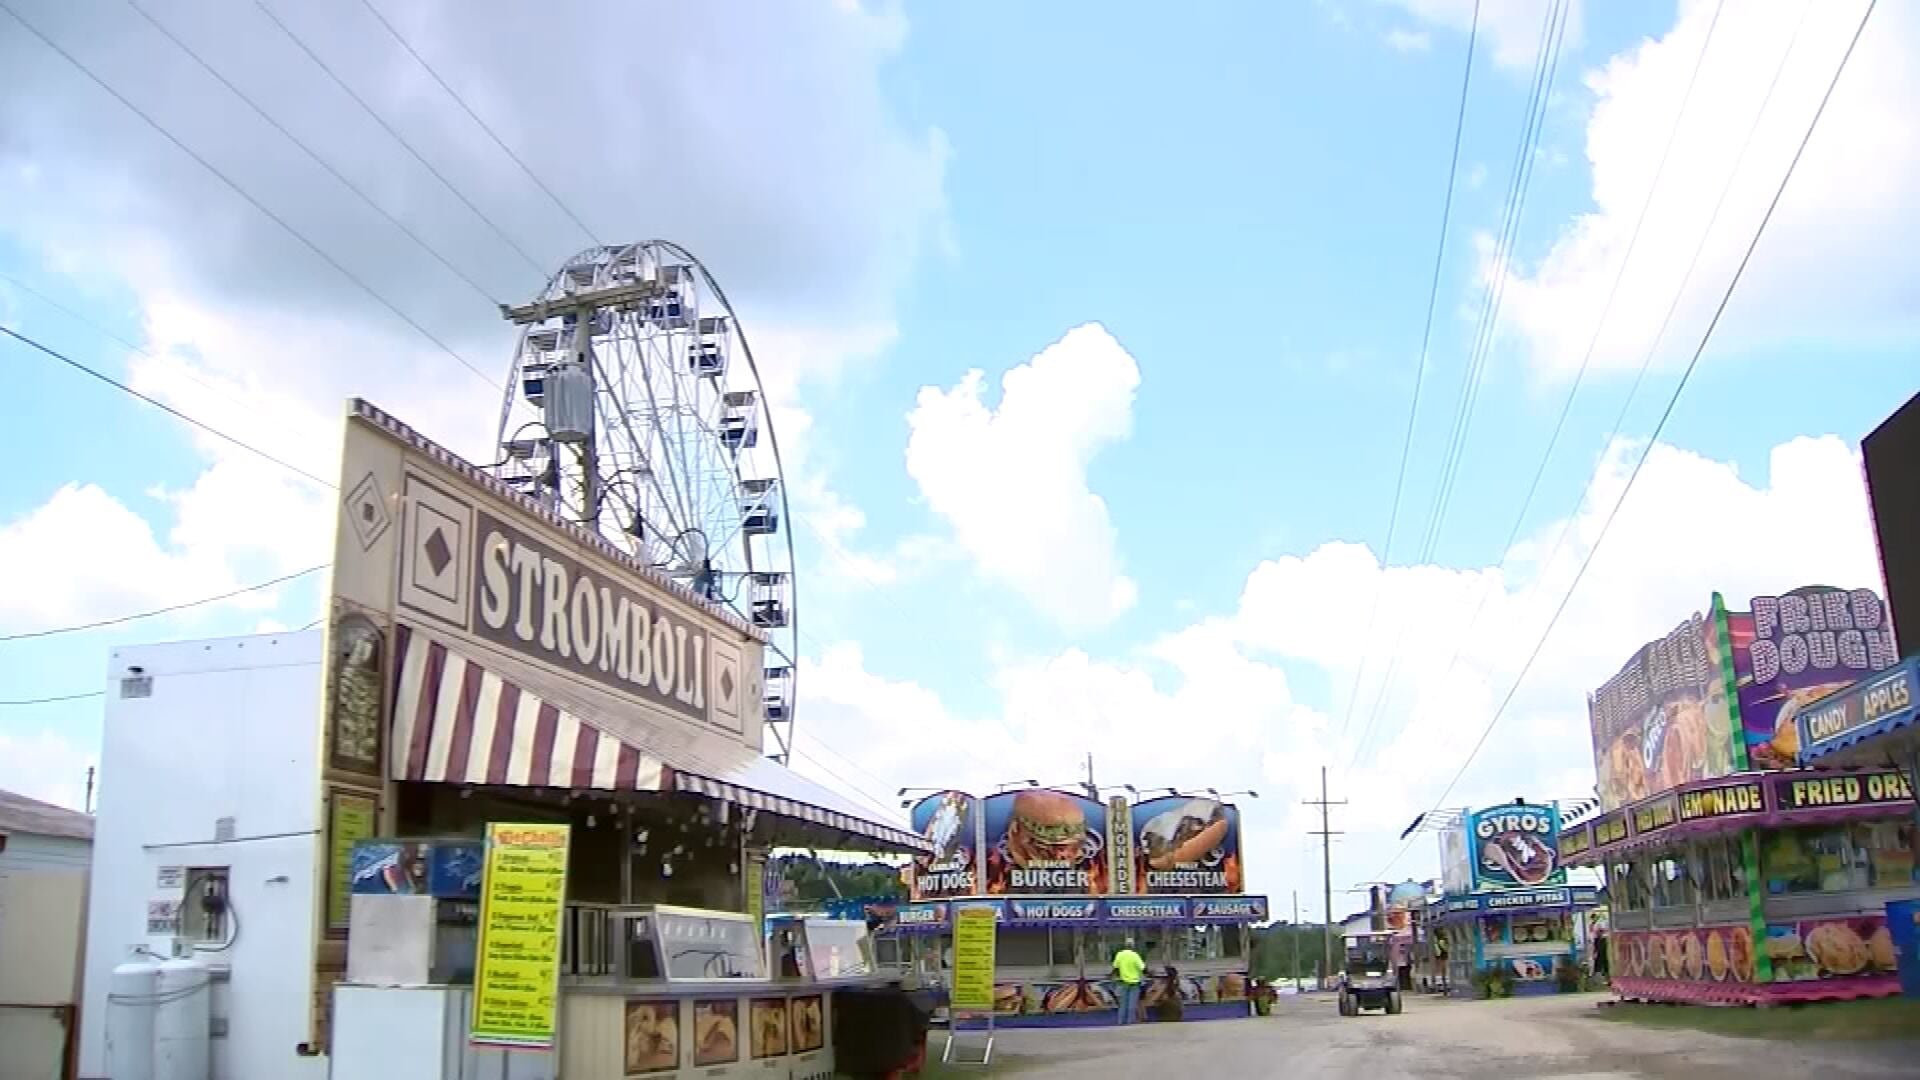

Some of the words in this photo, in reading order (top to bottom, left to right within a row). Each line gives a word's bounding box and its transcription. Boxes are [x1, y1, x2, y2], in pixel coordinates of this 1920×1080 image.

[481, 531, 705, 709] STROMBOLI
[1750, 588, 1880, 639] FRIED
[1749, 629, 1899, 685] DOUGH
[1810, 704, 1847, 742] CANDY
[1863, 677, 1910, 717] APPLES
[1682, 785, 1761, 819] LEMONADE
[1792, 776, 1860, 807] FRIED
[1477, 814, 1550, 837] GYROS
[1114, 800, 1128, 894] LEMONADE
[917, 874, 940, 892] HOT
[942, 870, 974, 890] DOGS
[1011, 869, 1089, 888] BURGER
[1146, 871, 1228, 887] CHEESESTEAK
[1027, 906, 1049, 918] HOT
[1052, 905, 1083, 918] DOGS
[1111, 905, 1180, 918] CHEESESTEAK
[1207, 903, 1250, 916] SAUSAGE
[1488, 895, 1533, 907] CHICKEN
